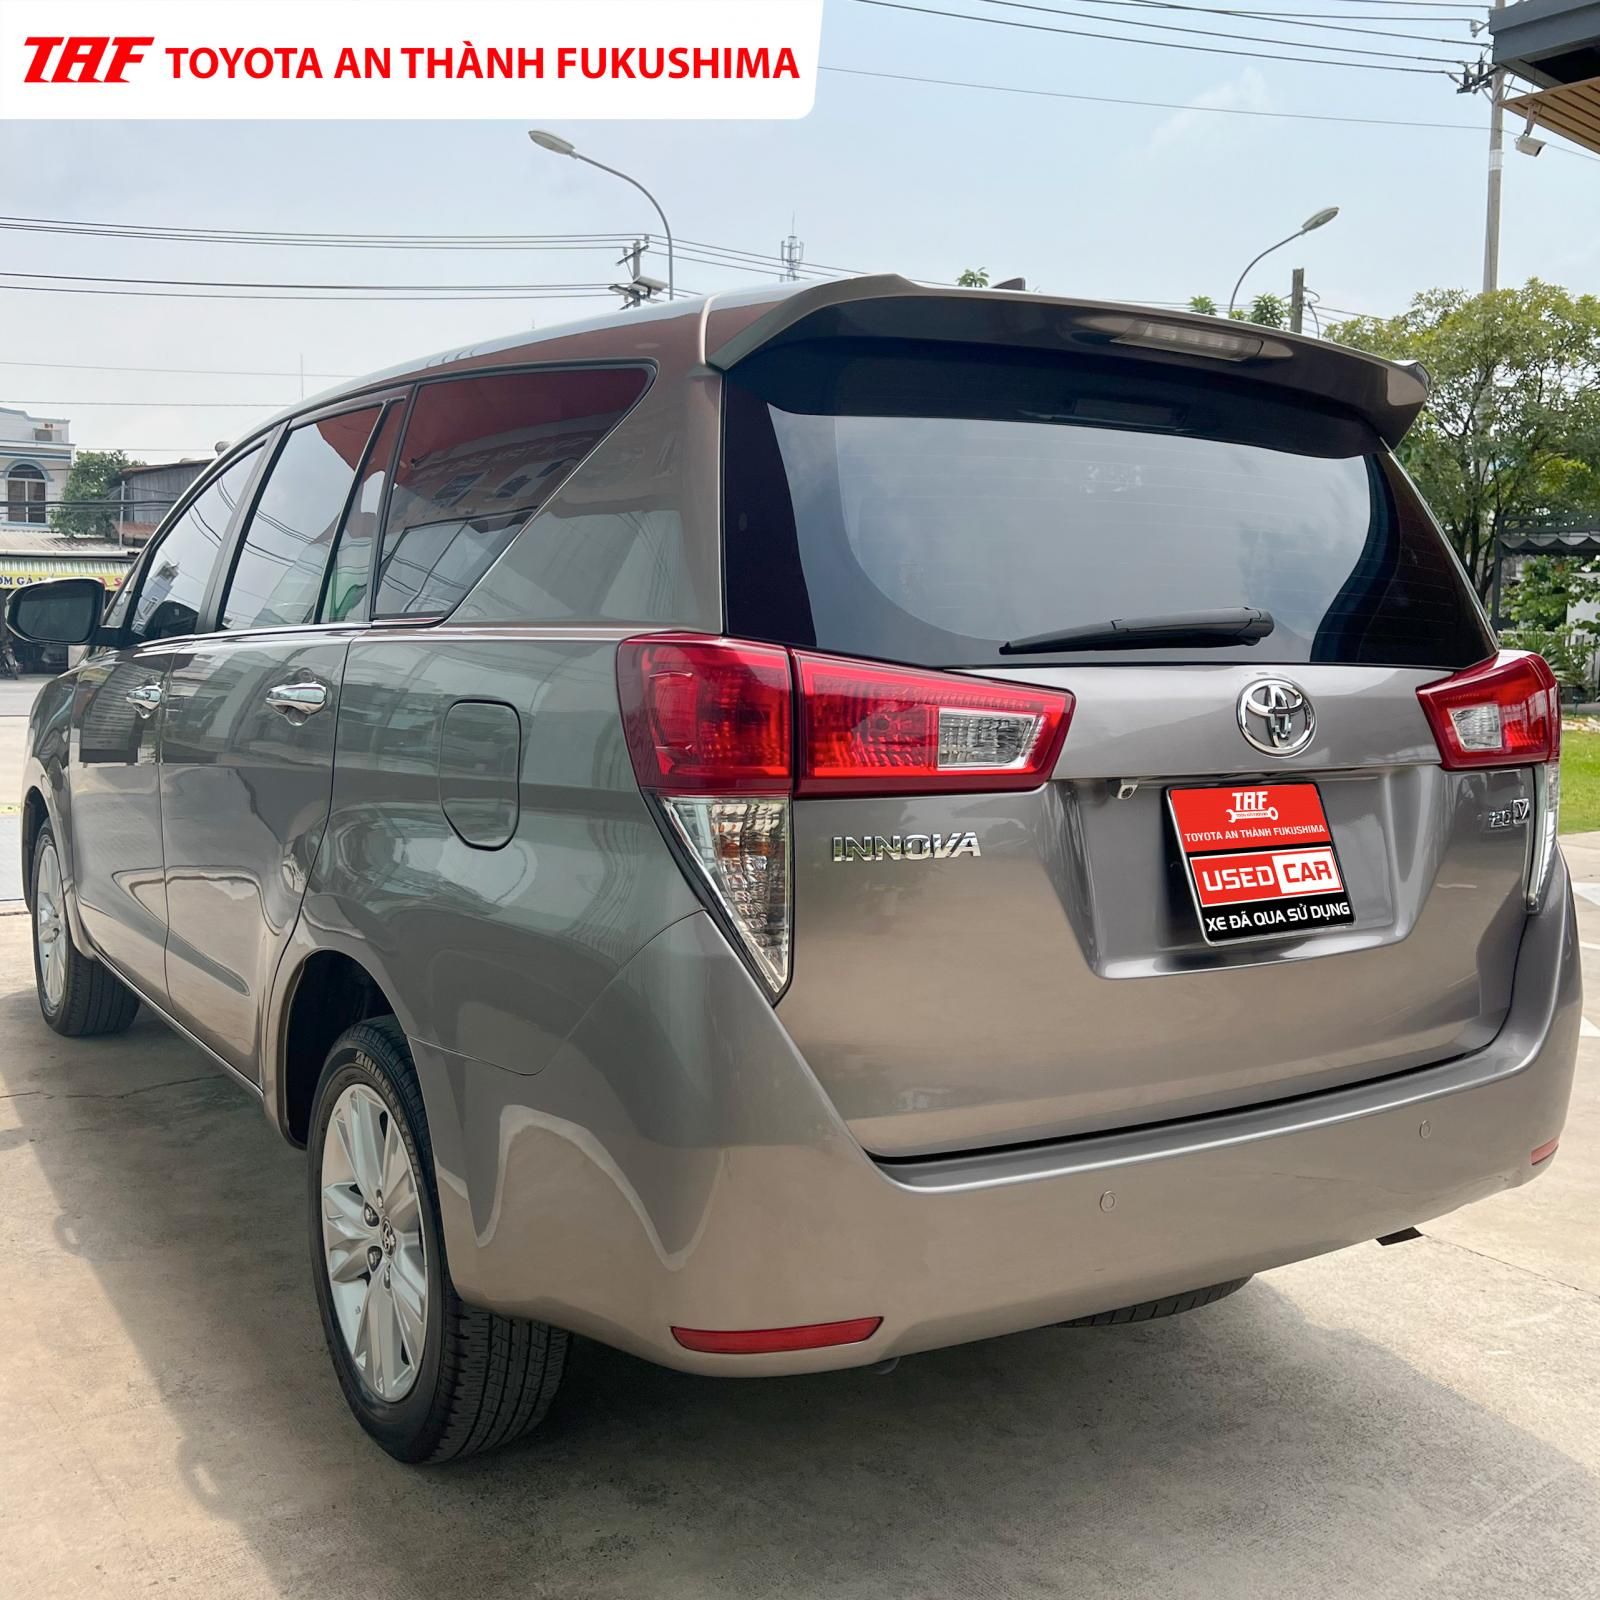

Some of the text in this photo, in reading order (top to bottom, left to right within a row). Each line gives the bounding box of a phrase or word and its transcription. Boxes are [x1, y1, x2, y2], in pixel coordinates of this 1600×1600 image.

[1231, 791, 1269, 811] TAF
[832, 831, 982, 862] INNOVA
[1184, 824, 1326, 843] TOYOTA AN THÀNH FUKUSHIMA
[1202, 860, 1333, 892] USED CAR
[1205, 902, 1351, 932] XE ĐÃ QUA SỬ DỤNG
